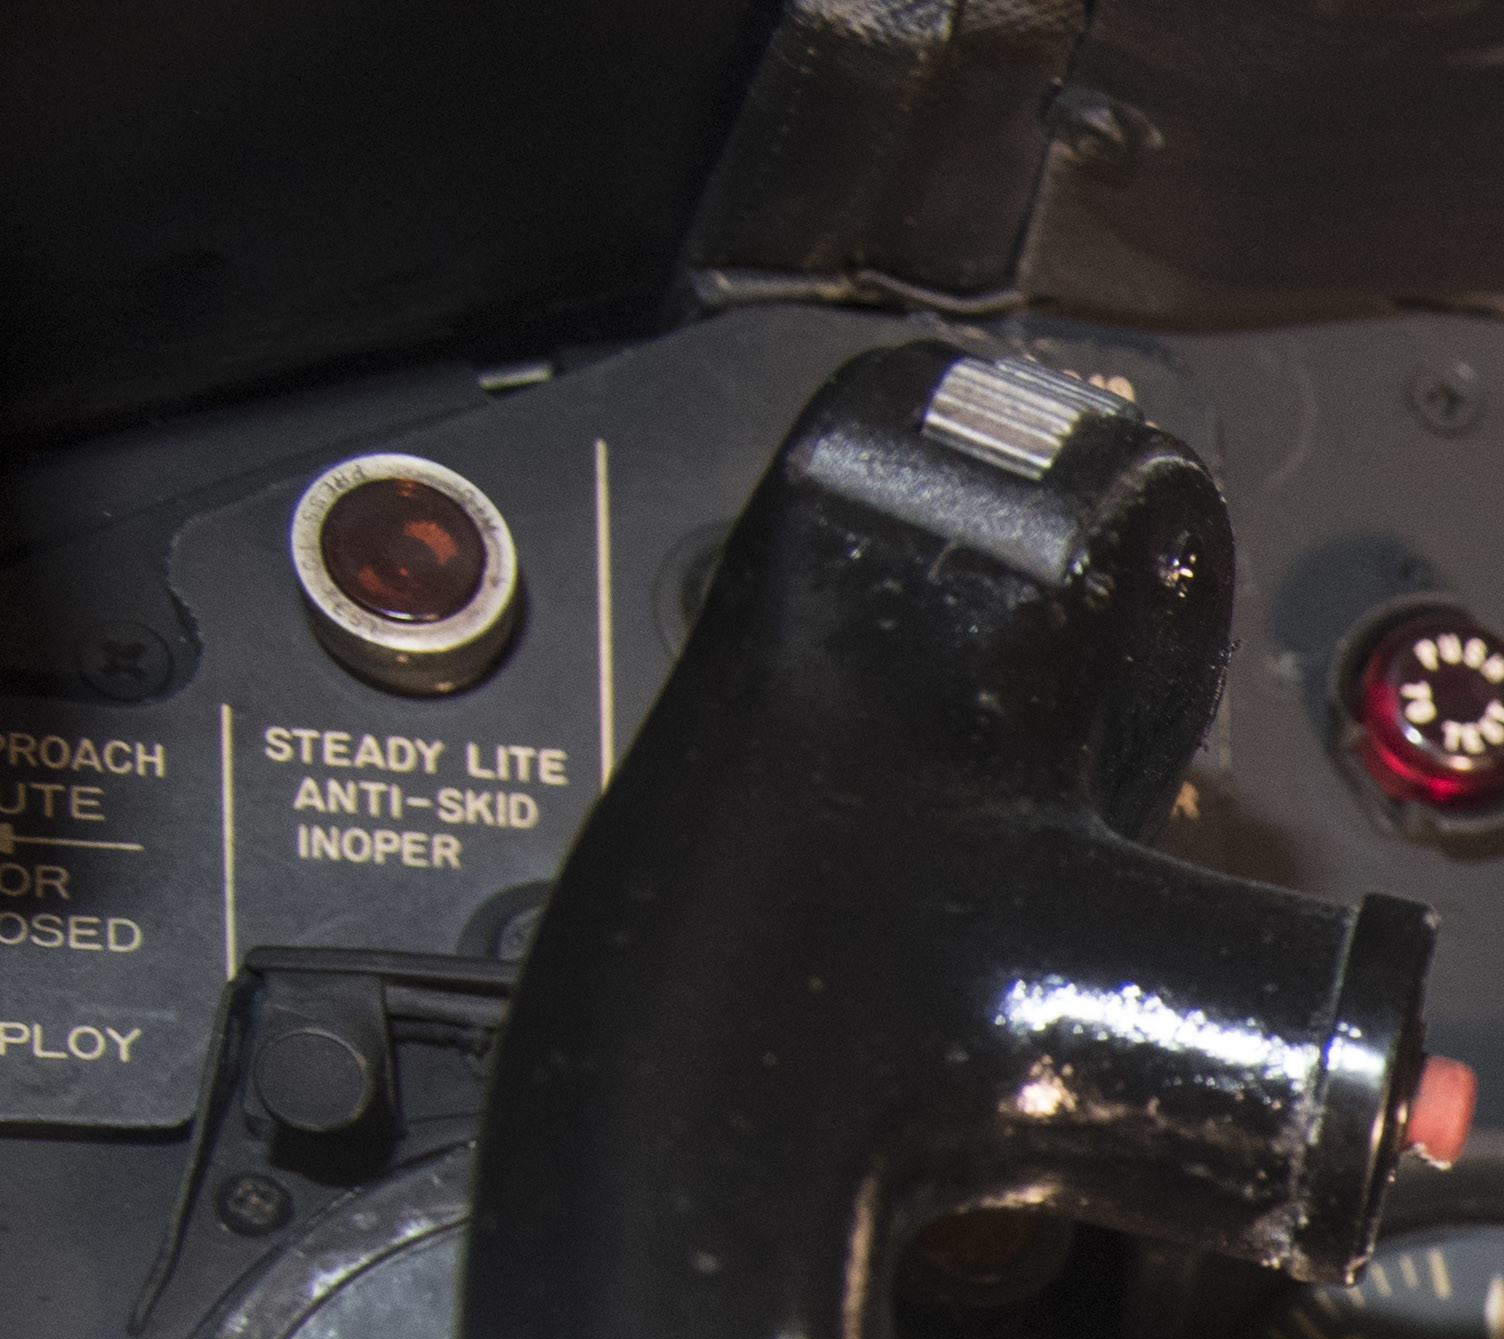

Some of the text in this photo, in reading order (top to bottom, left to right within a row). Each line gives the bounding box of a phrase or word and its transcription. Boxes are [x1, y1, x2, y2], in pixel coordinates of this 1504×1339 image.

[0, 732, 166, 778] ROACH
[265, 727, 568, 788] STEADY LITE
[294, 776, 540, 831] ANTI-SKID
[298, 825, 462, 869] INOPER
[0, 912, 143, 952] OSED
[0, 1021, 142, 1062] PLOY
